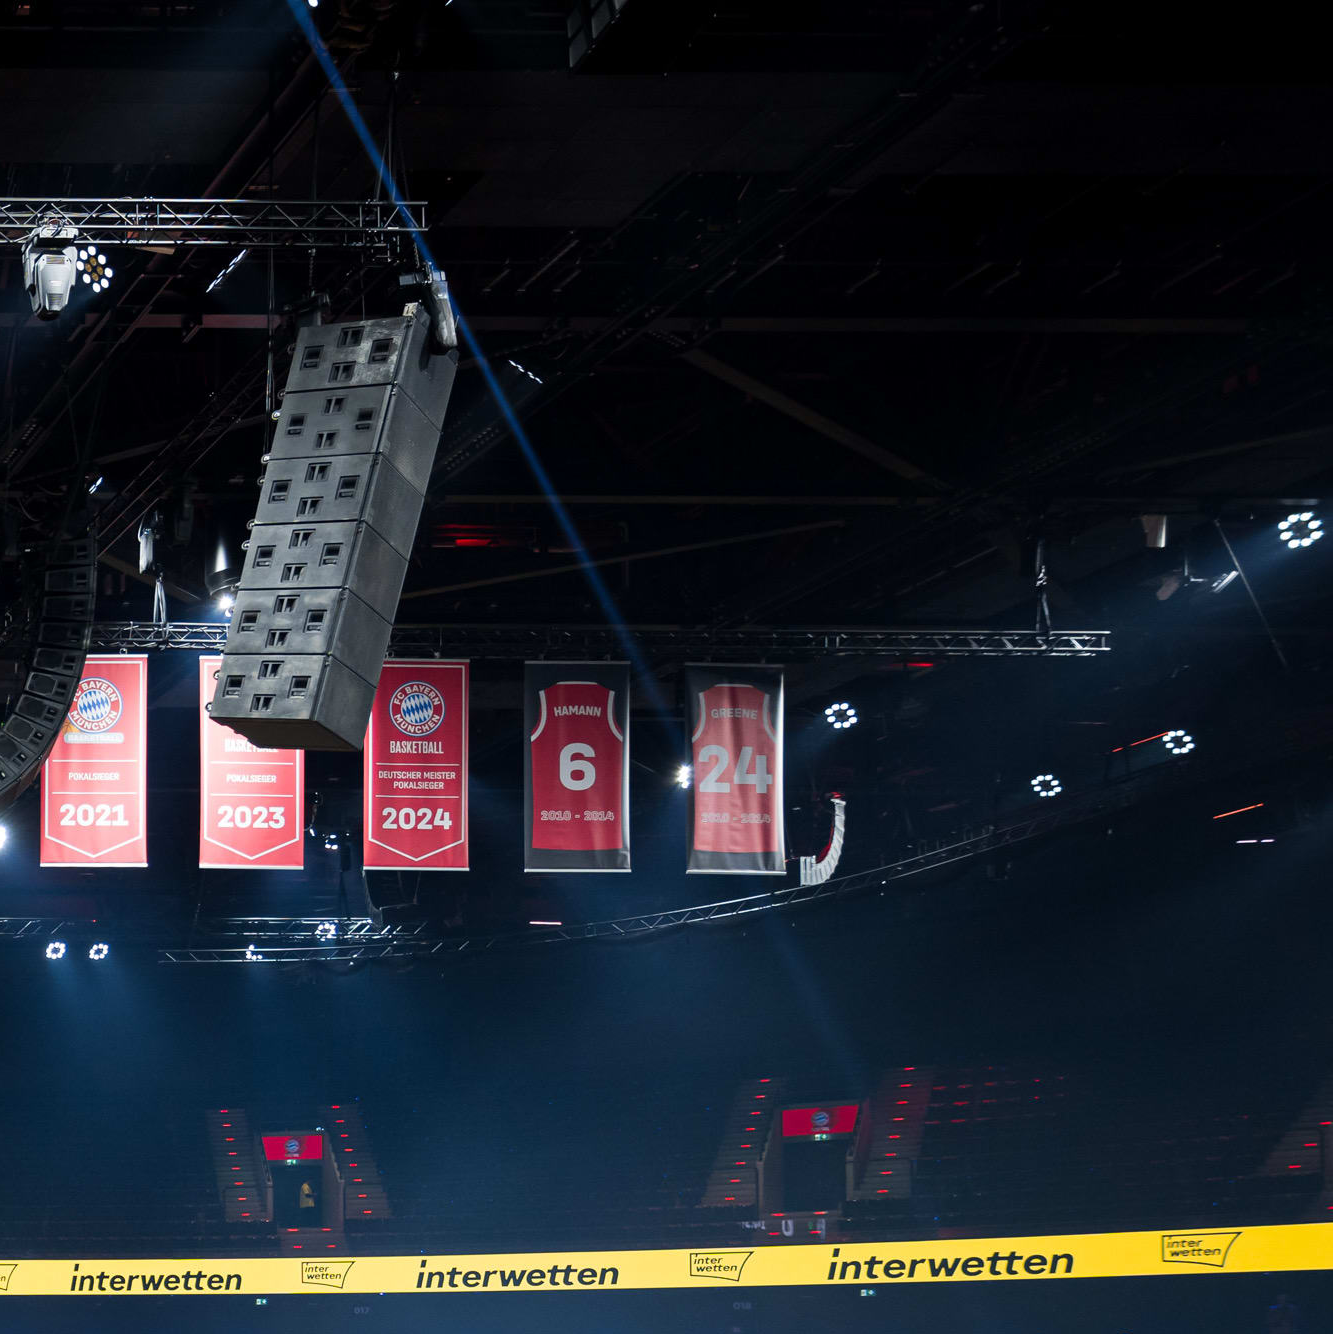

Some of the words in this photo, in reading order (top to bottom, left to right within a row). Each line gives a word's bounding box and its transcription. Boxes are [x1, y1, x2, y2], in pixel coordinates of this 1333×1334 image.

[81, 681, 118, 702] BAYERN
[404, 684, 441, 705] BAYERN
[554, 705, 602, 718] HAMANN
[711, 707, 758, 720] GREENE
[389, 740, 444, 754] BASKETBALL
[559, 742, 596, 790] 6
[699, 745, 773, 794] 24
[68, 772, 120, 781] POKALSIEGER
[226, 774, 277, 783] POKALSIEGER
[378, 771, 422, 780] DEUTSCHER
[424, 771, 456, 780] MEISTER
[393, 780, 445, 790] POKALSIEGER
[59, 804, 129, 826] 2021
[217, 805, 286, 829] 2023
[382, 807, 453, 830] 2024
[541, 810, 572, 821] 2010
[584, 810, 614, 821] 2014
[1166, 1235, 1203, 1250] inter
[1169, 1244, 1222, 1259] wetten
[693, 1254, 723, 1266] inter
[828, 1247, 1075, 1282] interwetten
[304, 1263, 332, 1274] inter
[416, 1259, 619, 1291] interwetten
[694, 1263, 739, 1274] wetten
[70, 1263, 242, 1292] interwetten
[306, 1271, 343, 1283] wetten
